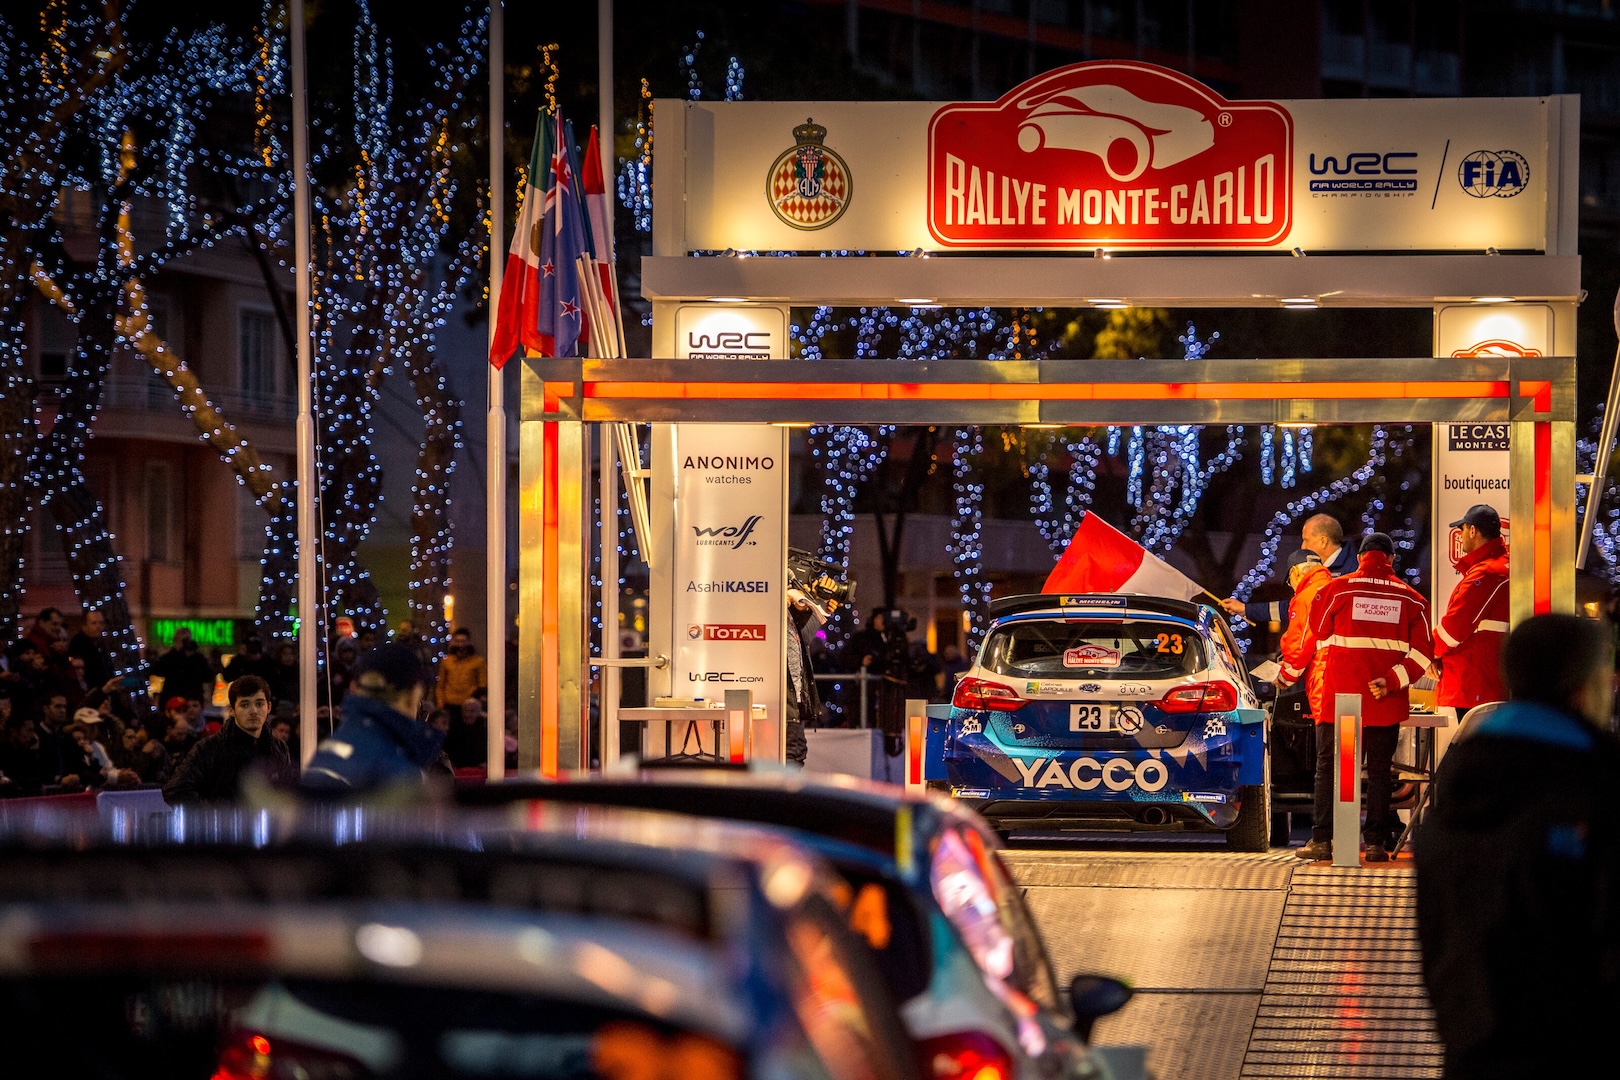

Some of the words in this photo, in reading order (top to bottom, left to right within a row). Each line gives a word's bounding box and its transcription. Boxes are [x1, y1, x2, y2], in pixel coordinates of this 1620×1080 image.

[1309, 152, 1418, 175] WRC
[946, 152, 1046, 225] RALLYE
[1057, 153, 1275, 225] MONTE-CARLO
[1375, 181, 1415, 189] RALLY
[688, 331, 771, 349] WRC
[1451, 425, 1468, 439] LE
[683, 456, 774, 470] ANONIMO
[705, 475, 752, 484] watches
[705, 626, 764, 639] TOTAL
[1156, 633, 1184, 655] 23
[1067, 656, 1083, 664] RALLYE
[1078, 706, 1102, 730] 23
[1011, 757, 1169, 792] YACCO
